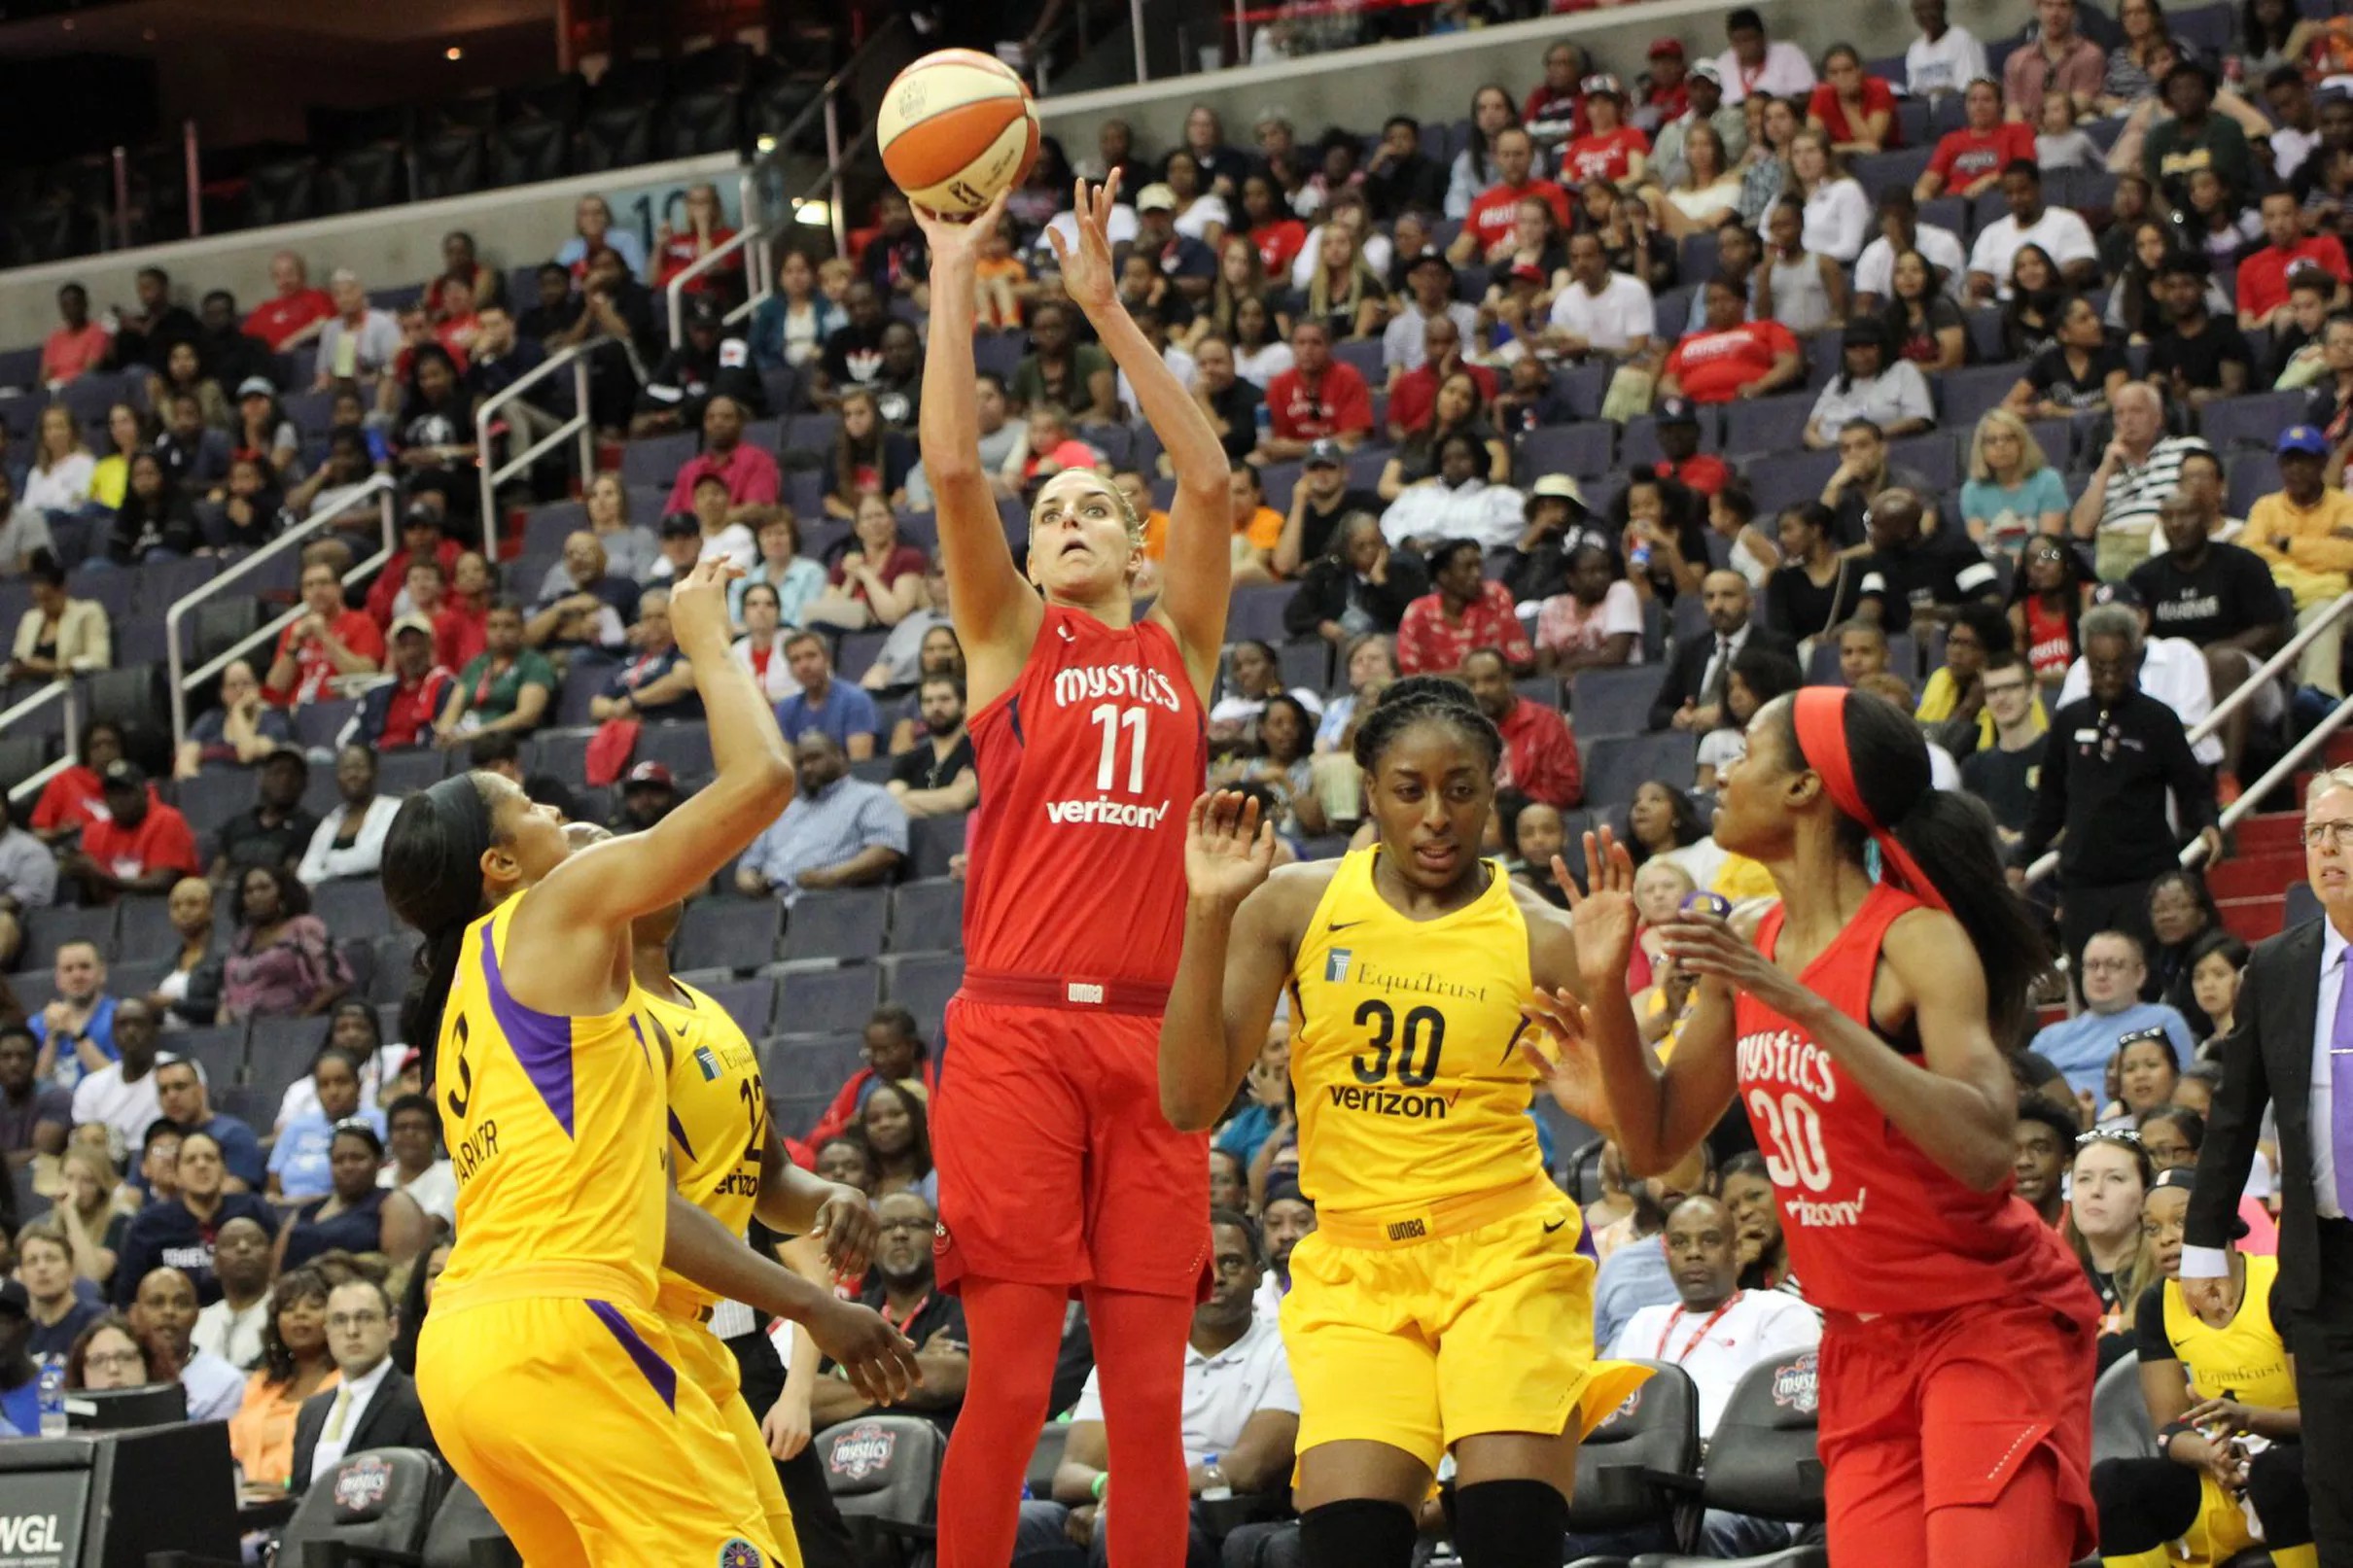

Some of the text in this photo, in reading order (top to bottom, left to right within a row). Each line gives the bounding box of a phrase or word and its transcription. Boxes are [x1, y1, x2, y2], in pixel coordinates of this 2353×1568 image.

[1091, 703, 1147, 794] 11
[1046, 794, 1156, 829] verizon
[1358, 962, 1489, 1002] EquiTrust
[1352, 998, 1446, 1088] 30
[447, 1010, 472, 1119] 3
[1329, 1085, 1446, 1119] verizon
[1748, 1088, 1833, 1193] 30
[714, 1167, 758, 1198] erizo
[1785, 1194, 1859, 1227] rizon
